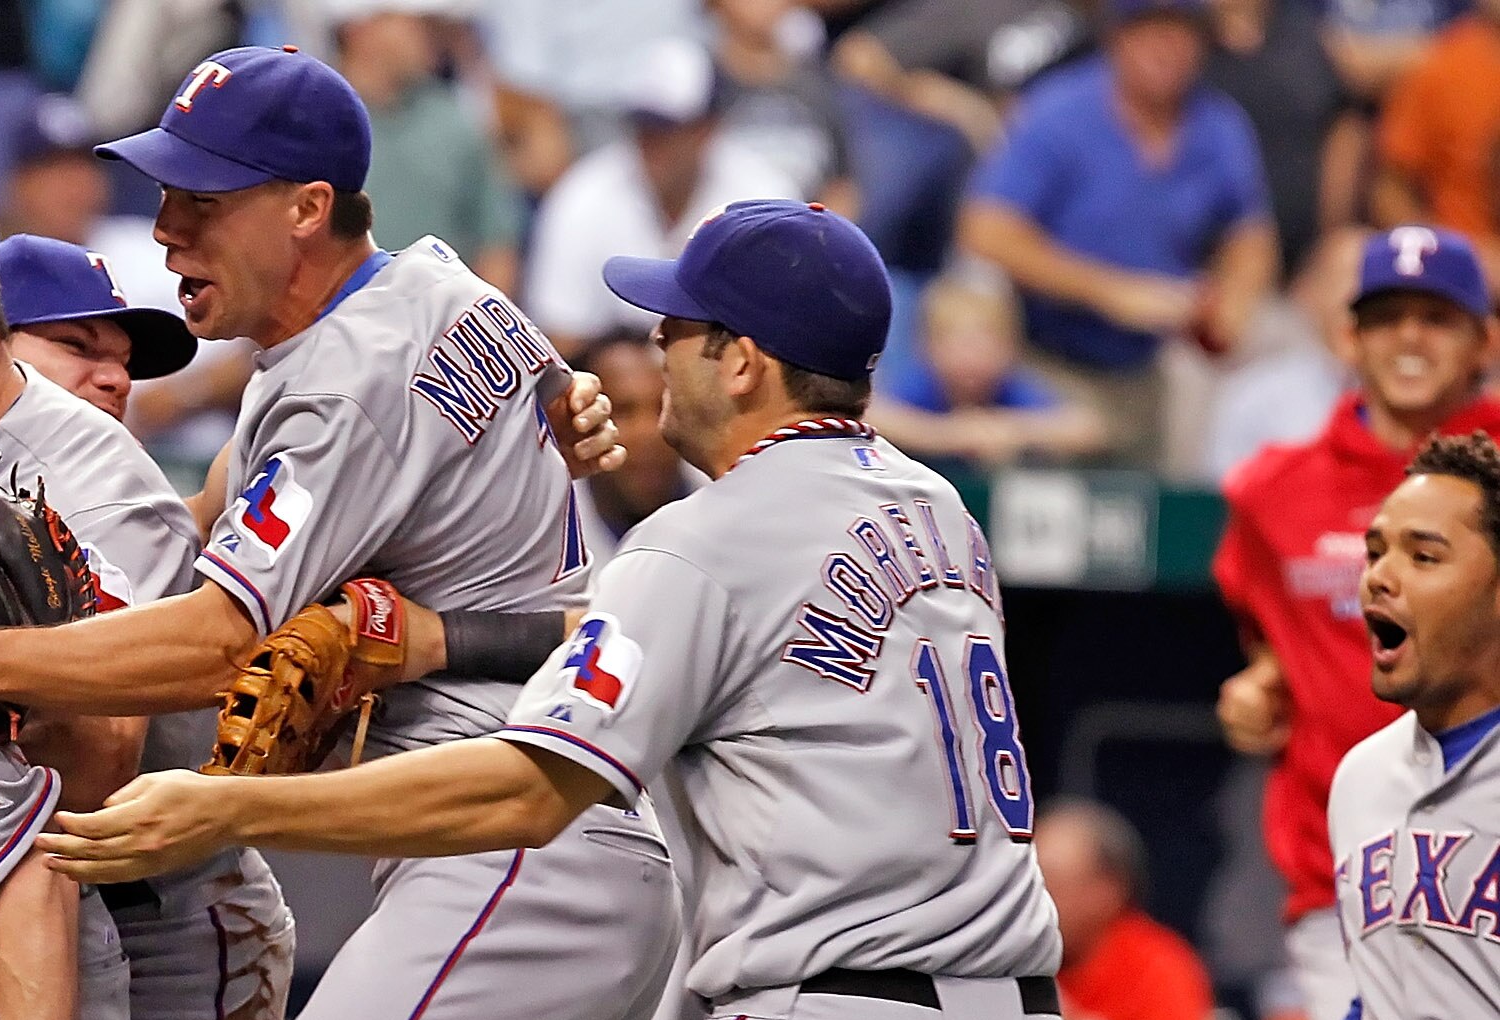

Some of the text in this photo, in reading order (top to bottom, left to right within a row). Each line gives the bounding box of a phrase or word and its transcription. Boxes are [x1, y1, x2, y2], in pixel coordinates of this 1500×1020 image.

[175, 60, 233, 113] T
[1387, 226, 1439, 278] T
[409, 294, 574, 447] MUR
[780, 498, 1006, 694] MORELA
[910, 633, 1035, 844] 18
[1334, 828, 1500, 945] EXA
